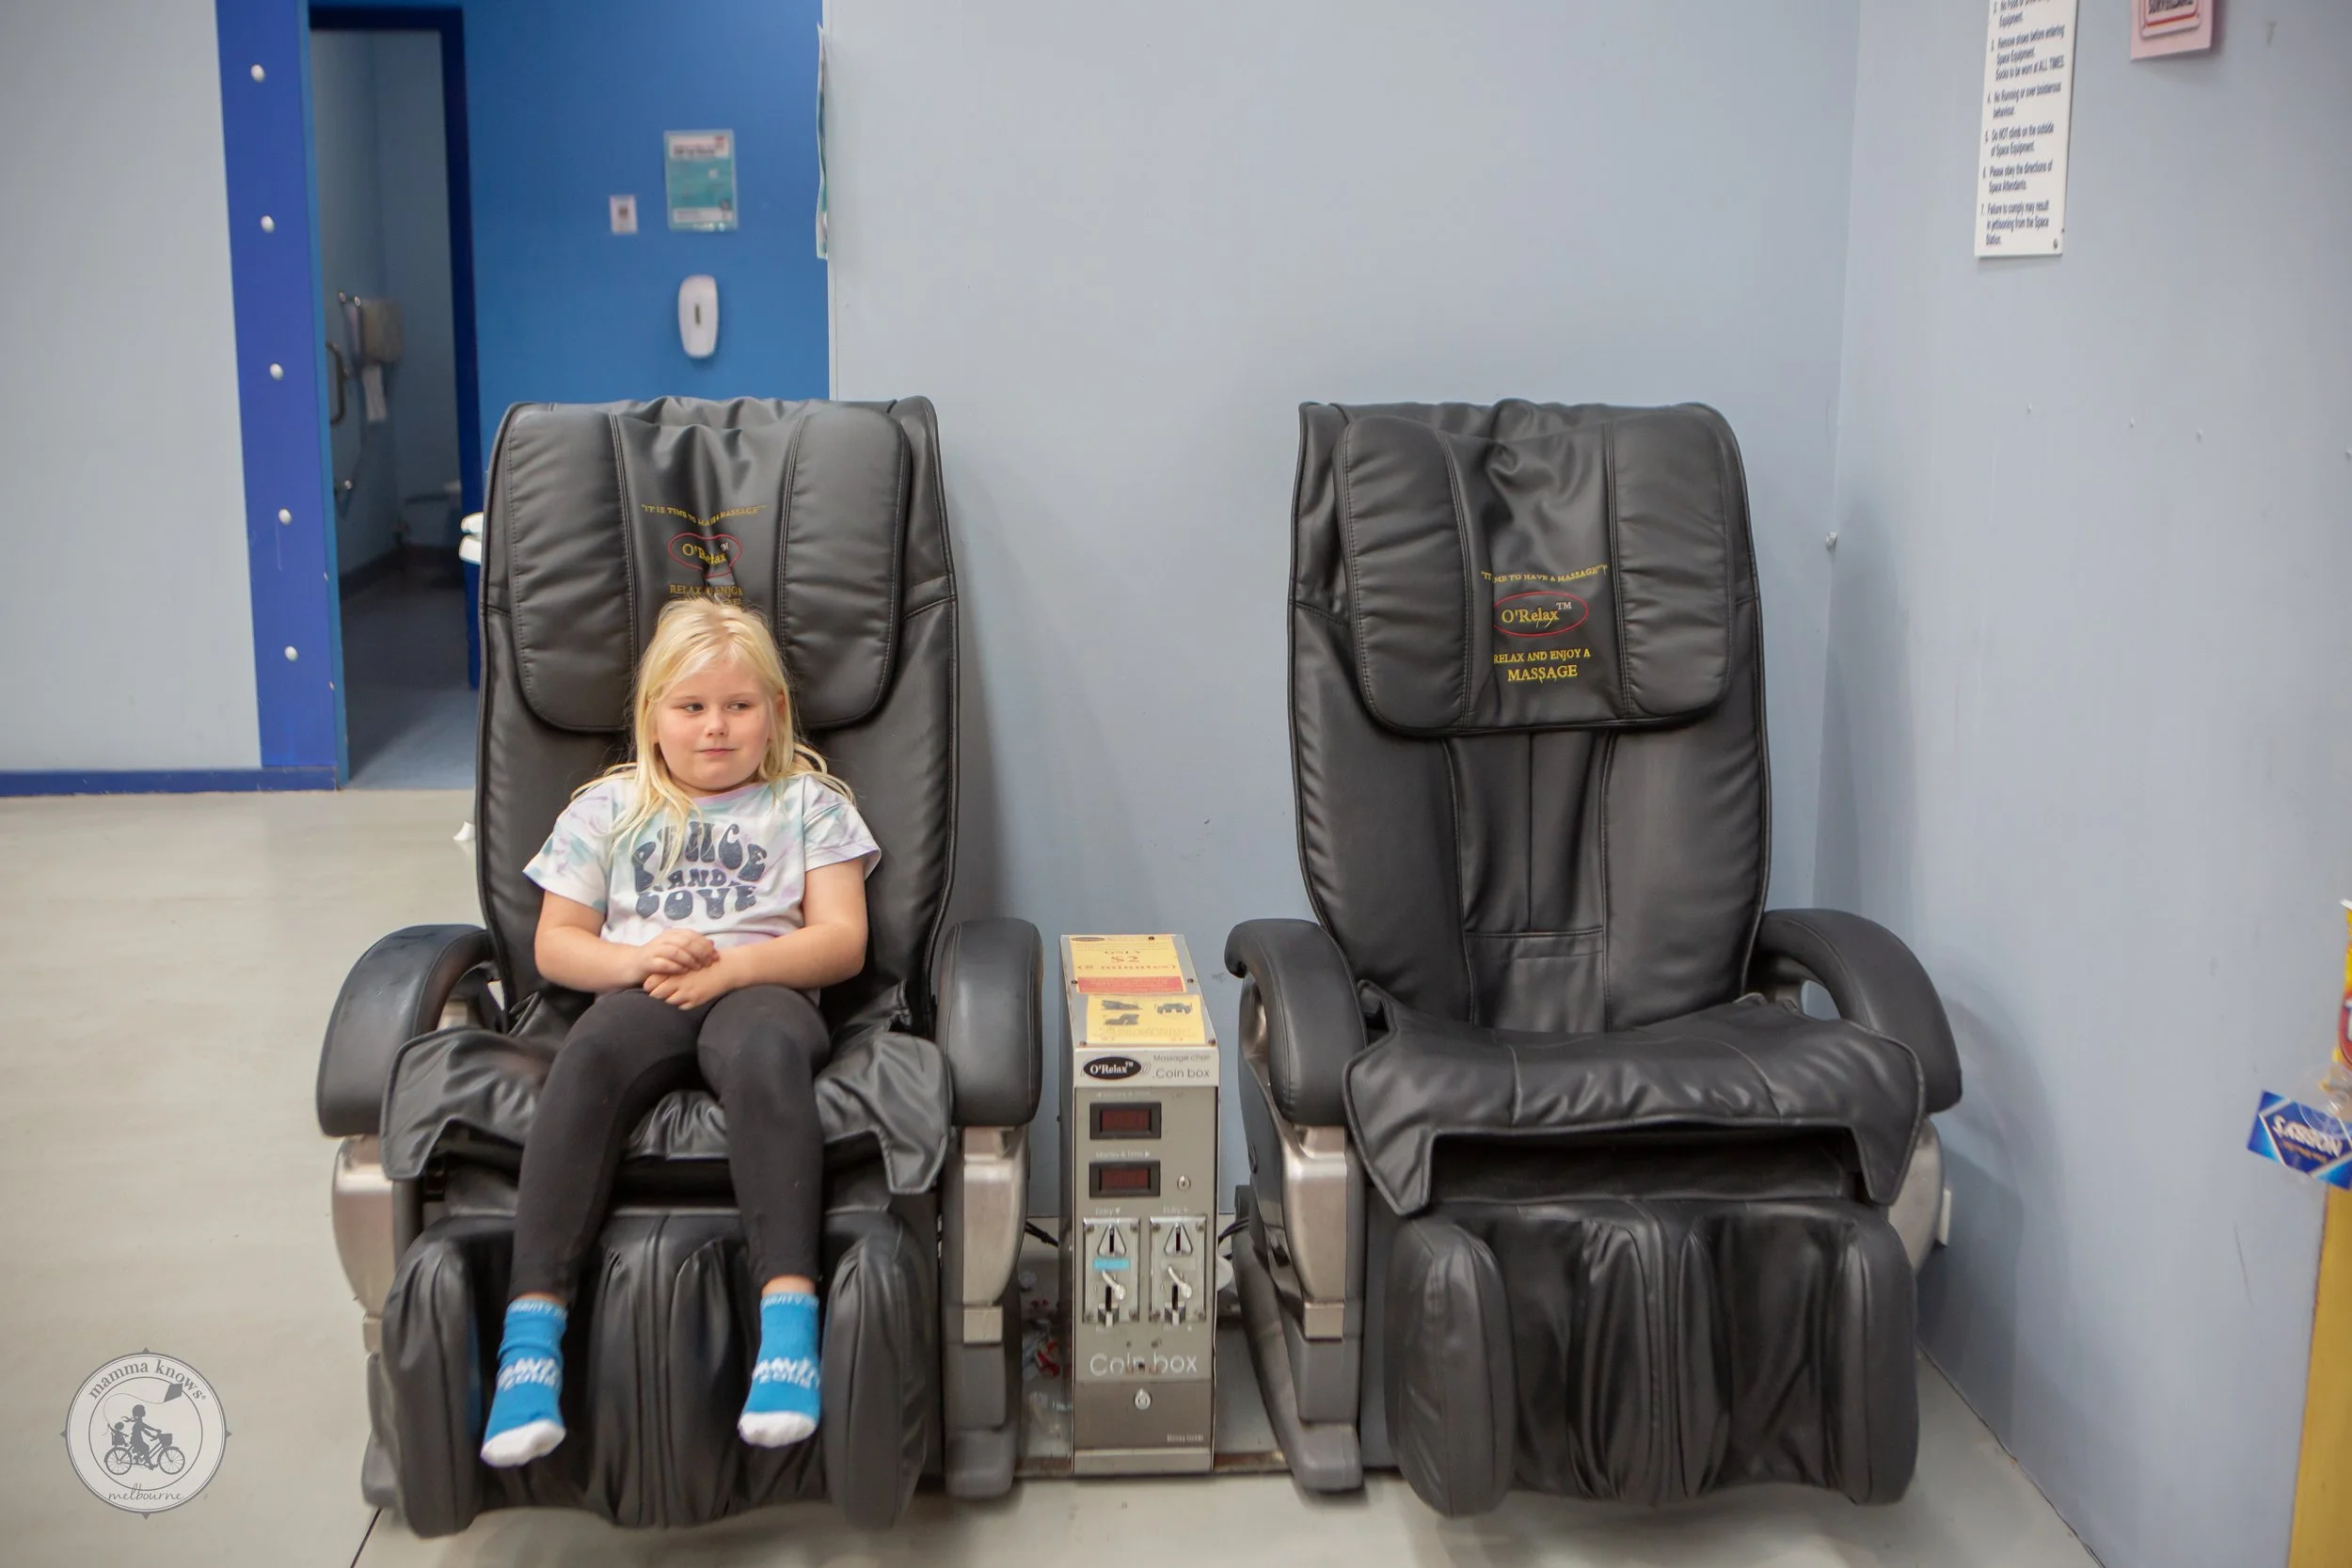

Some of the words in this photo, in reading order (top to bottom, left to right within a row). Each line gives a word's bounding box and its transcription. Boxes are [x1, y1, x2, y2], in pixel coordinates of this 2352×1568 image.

[1999, 126, 2009, 139] NOT
[1996, 143, 2010, 157] Space
[1989, 181, 2001, 196] Space
[2035, 215, 2049, 230] Space
[1494, 652, 1524, 664] RELAX
[1527, 650, 1547, 661] AND
[1549, 649, 1581, 661] ENJOY
[1583, 648, 1591, 657] A
[1507, 664, 1578, 682] MASSAGE
[668, 868, 727, 890] AND
[1089, 1064, 1127, 1075] O'Relax
[1187, 1068, 1210, 1078] box
[1153, 1351, 1198, 1374] box
